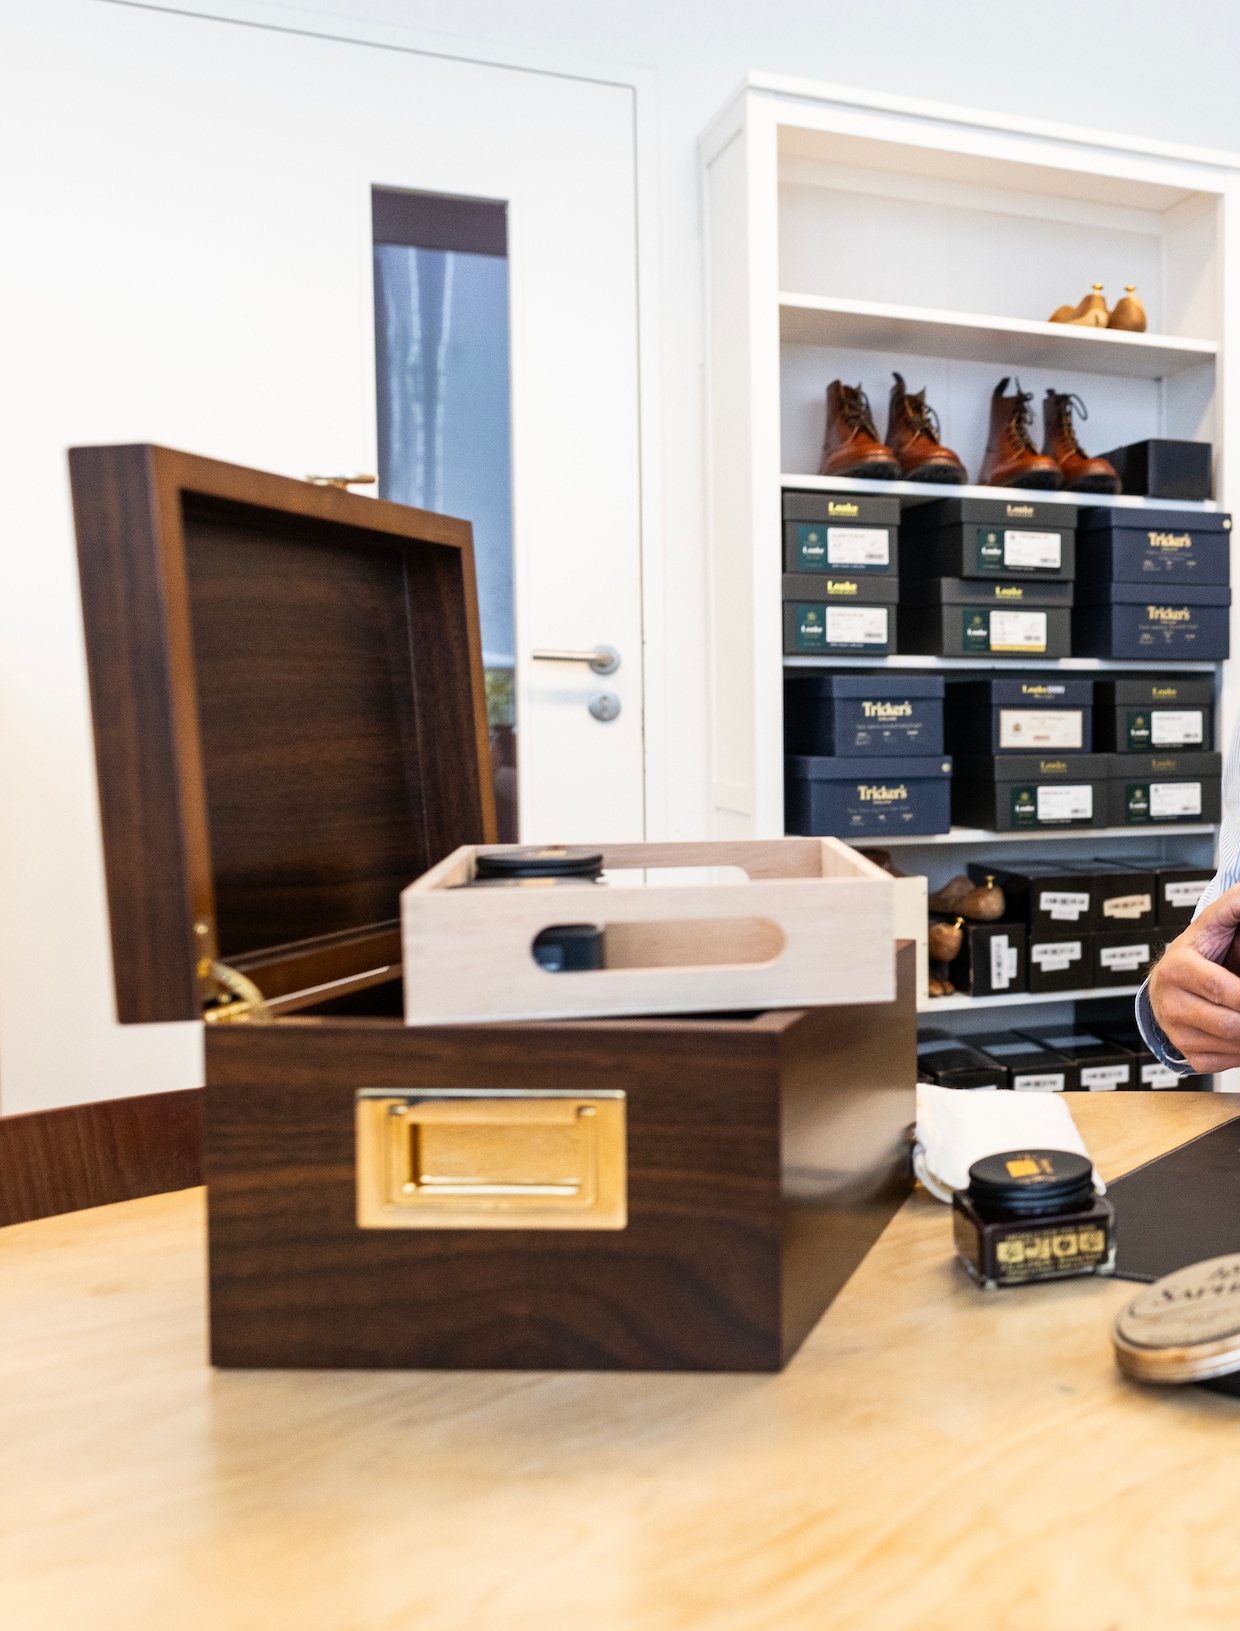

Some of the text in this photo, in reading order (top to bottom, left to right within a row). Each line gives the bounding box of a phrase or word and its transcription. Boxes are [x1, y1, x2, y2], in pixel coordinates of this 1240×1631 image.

[1147, 531, 1192, 548] Tricker's
[1146, 605, 1191, 621] Tricker's
[861, 701, 913, 717] Tricker's
[857, 784, 908, 801] Tricker's
